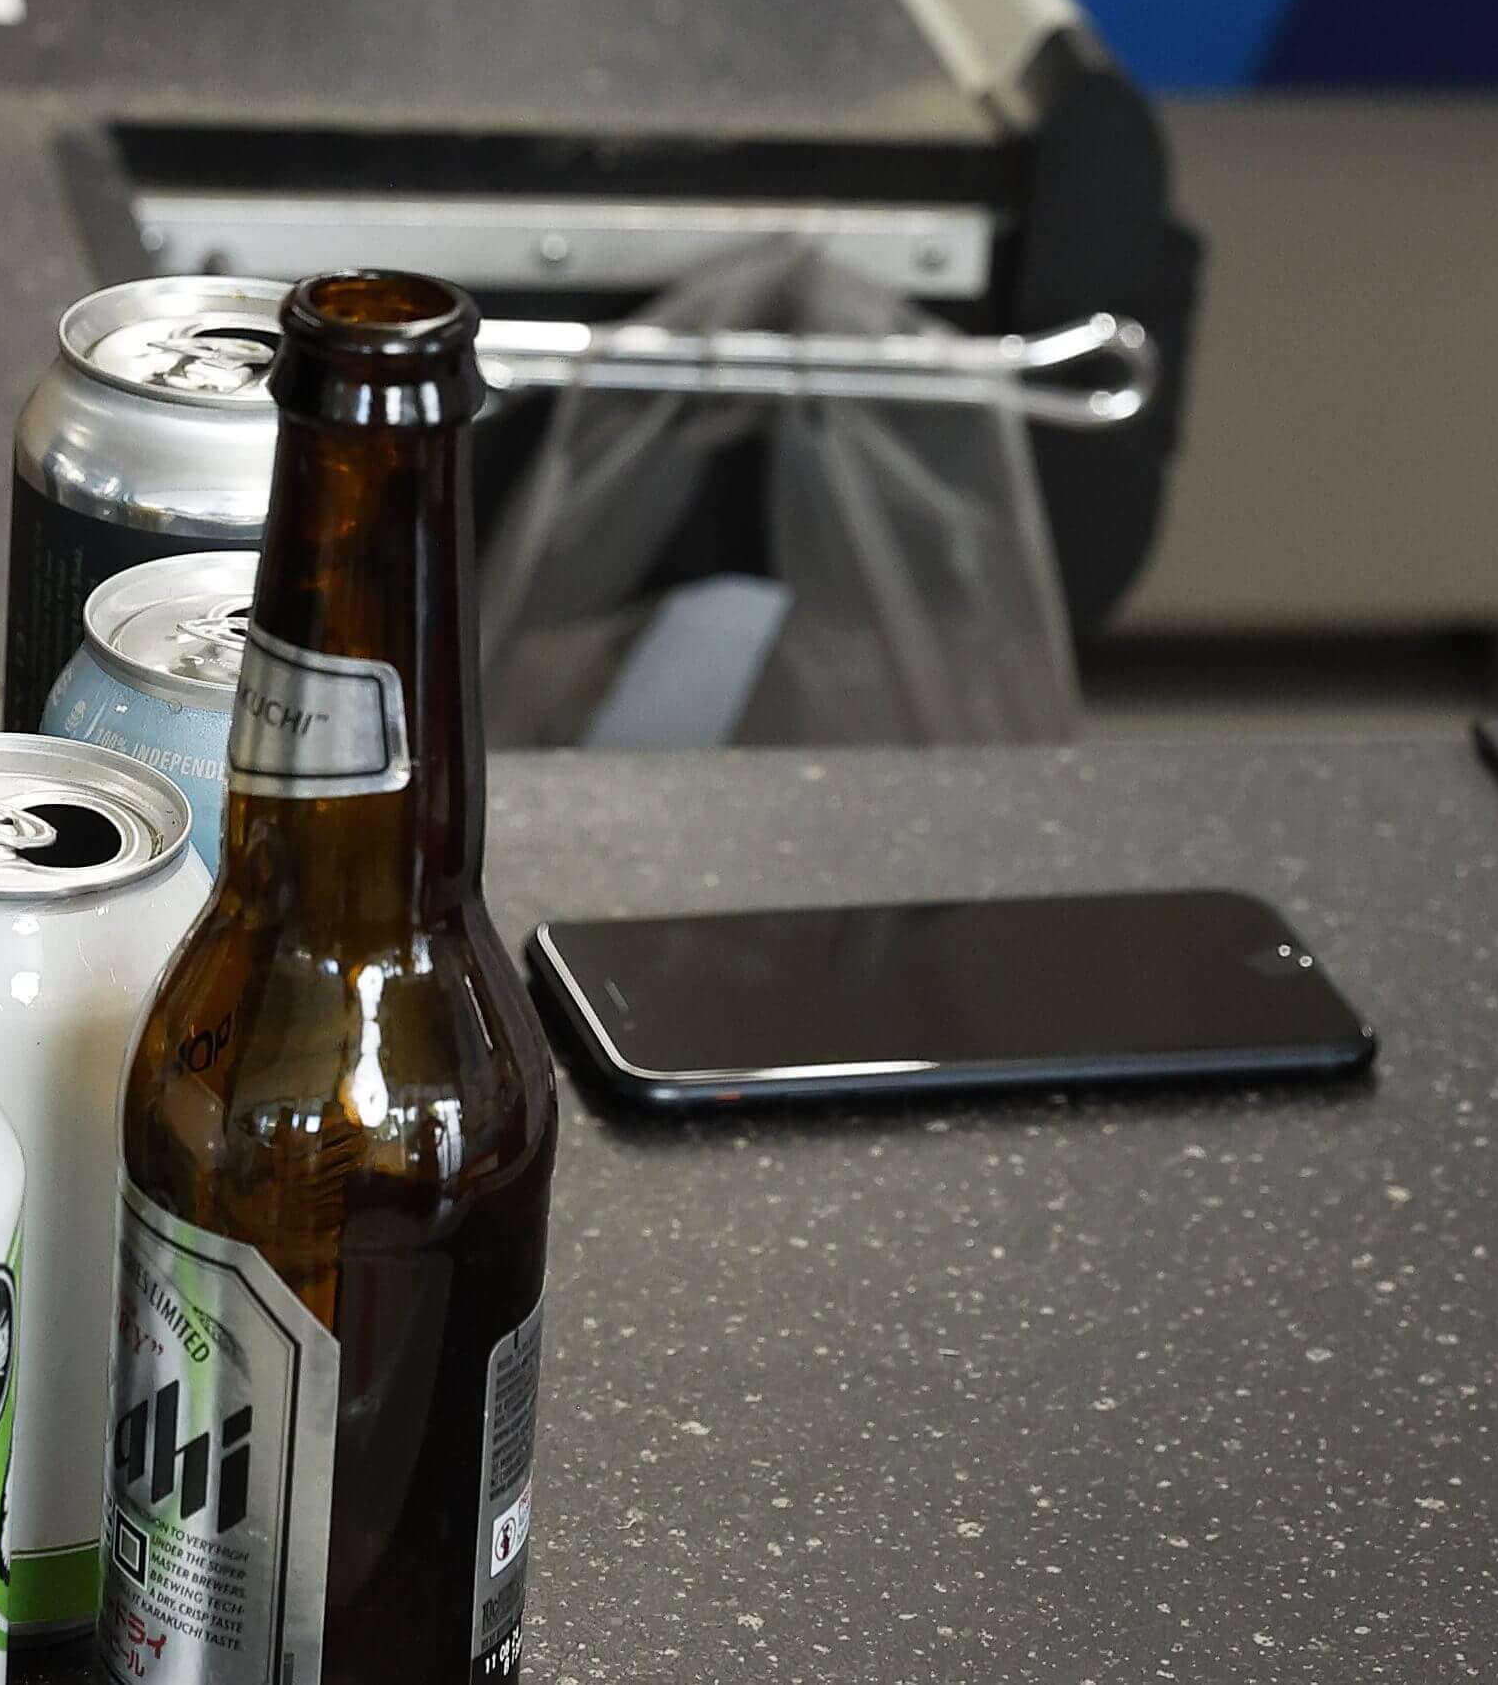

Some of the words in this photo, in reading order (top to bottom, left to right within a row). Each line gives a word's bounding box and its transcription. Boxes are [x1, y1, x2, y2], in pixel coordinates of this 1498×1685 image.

[148, 1282, 210, 1363] LIMITED
[152, 1553, 189, 1579] MASTER
[149, 1569, 204, 1604] BREWING
[141, 1601, 204, 1641] KARAKUCHI
[211, 1616, 243, 1635] TASTE
